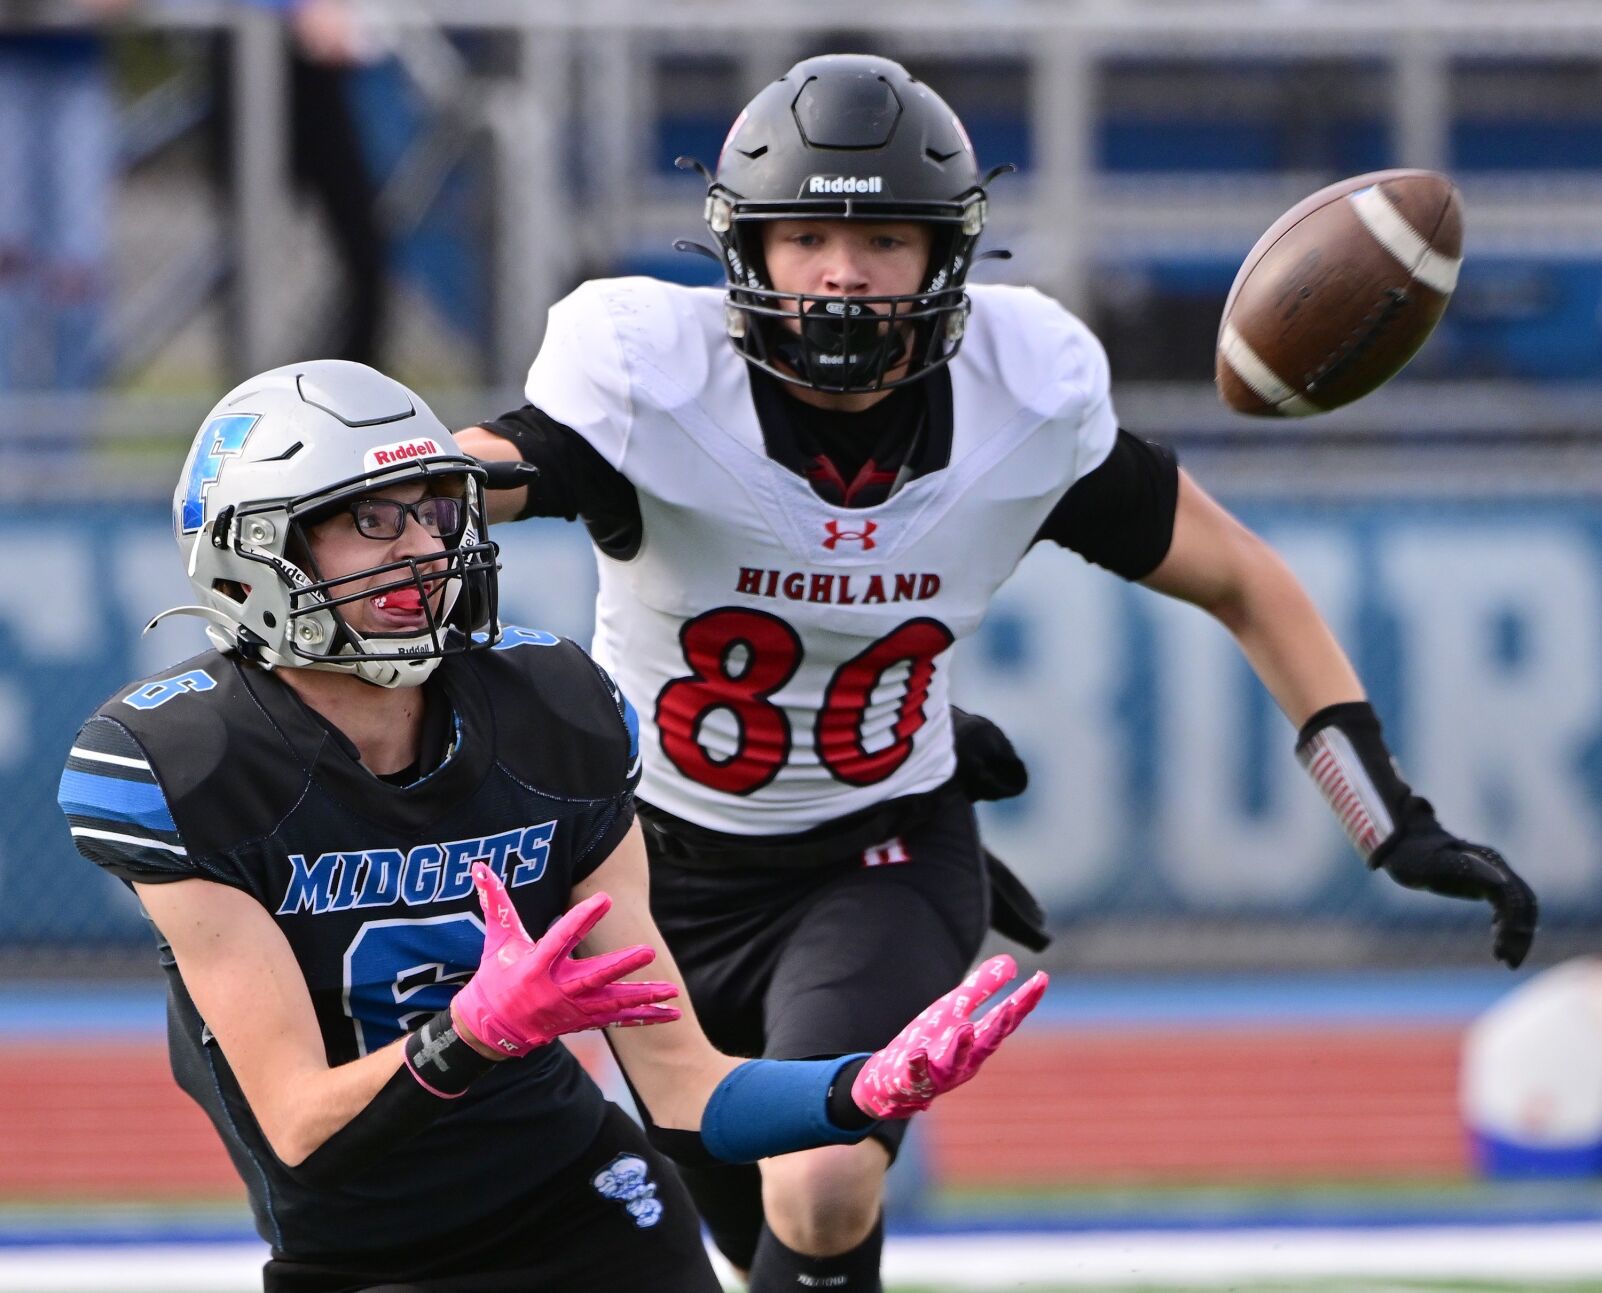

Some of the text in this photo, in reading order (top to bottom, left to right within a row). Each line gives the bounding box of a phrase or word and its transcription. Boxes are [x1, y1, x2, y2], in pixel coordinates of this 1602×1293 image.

[809, 175, 882, 193] Riddell
[373, 440, 437, 466] Riddell
[181, 413, 262, 535] F
[735, 567, 941, 605] HIGHLAND
[122, 669, 217, 710] 6
[655, 606, 954, 795] 80
[275, 820, 558, 916] MIDGETS
